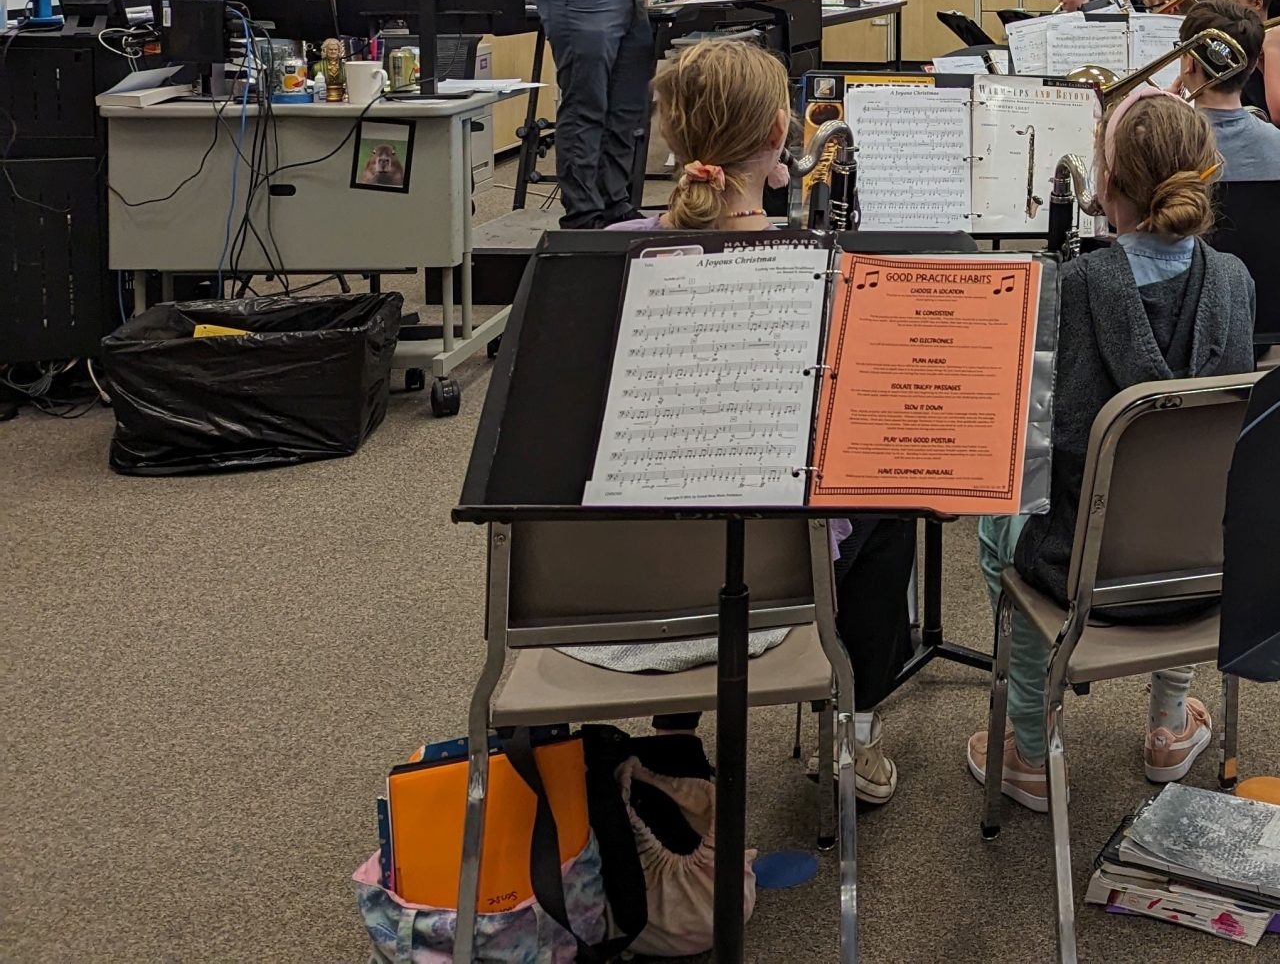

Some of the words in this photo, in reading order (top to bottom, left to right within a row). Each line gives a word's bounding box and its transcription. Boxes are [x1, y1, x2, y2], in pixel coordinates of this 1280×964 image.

[1035, 89, 1051, 99] AND
[1056, 88, 1090, 102] BEYOND
[696, 259, 704, 267] A
[705, 257, 734, 268] Joyous
[734, 255, 777, 265] Christmas
[886, 272, 913, 282] GOOD
[915, 273, 958, 284] PRACTICE
[960, 274, 992, 284] HABITS
[893, 468, 924, 476] EQUIPMENT
